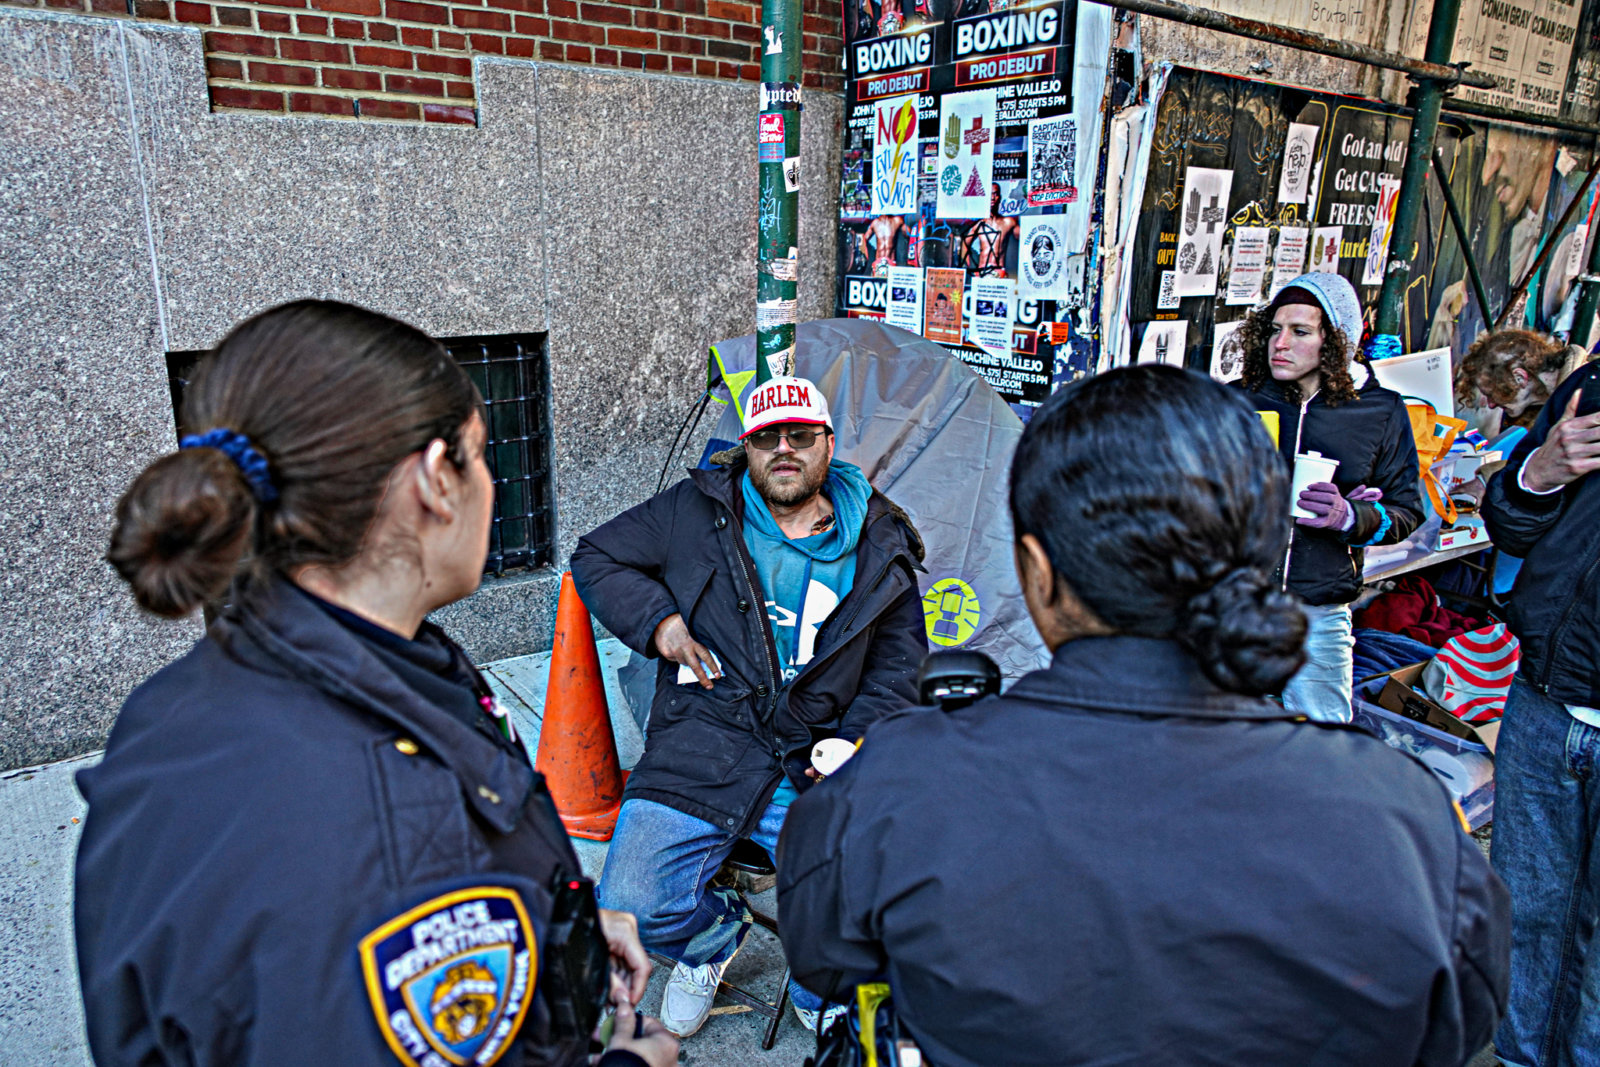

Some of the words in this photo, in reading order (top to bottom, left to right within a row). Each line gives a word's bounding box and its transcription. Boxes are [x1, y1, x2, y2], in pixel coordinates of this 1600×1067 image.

[1311, 2, 1366, 34] Brutality
[1509, 6, 1533, 29] GRAY
[957, 8, 1058, 55] BOXING
[1531, 15, 1557, 39] CONAN
[1555, 22, 1576, 45] GRAY
[857, 33, 931, 73] BOXING
[969, 61, 997, 80] PRO
[998, 54, 1046, 76] DEBUT
[868, 80, 888, 96] PRO
[888, 73, 923, 93] DEBUT
[1016, 80, 1061, 96] VALLEJO
[998, 107, 1038, 120] BALLROOM
[1018, 98, 1047, 109] STARTS
[1047, 97, 1053, 106] 5
[1053, 95, 1067, 105] PM
[877, 105, 917, 146] NO
[1032, 120, 1075, 133] CAPITALISM
[1341, 133, 1365, 158] Got
[1365, 141, 1382, 160] an
[1384, 140, 1404, 162] old
[1335, 168, 1358, 193] Get
[1328, 203, 1365, 226] FREE
[1160, 232, 1175, 243] BACK
[1157, 249, 1176, 265] OUT
[961, 349, 1000, 366] MACHINE
[1001, 356, 1044, 373] VALLEJO
[1003, 370, 1031, 383] STARTS
[1031, 374, 1036, 382] 5
[1036, 375, 1048, 385] PM
[751, 385, 811, 418] HARLEM
[411, 900, 491, 946] POLICE
[385, 919, 518, 991] DEPARTMENT
